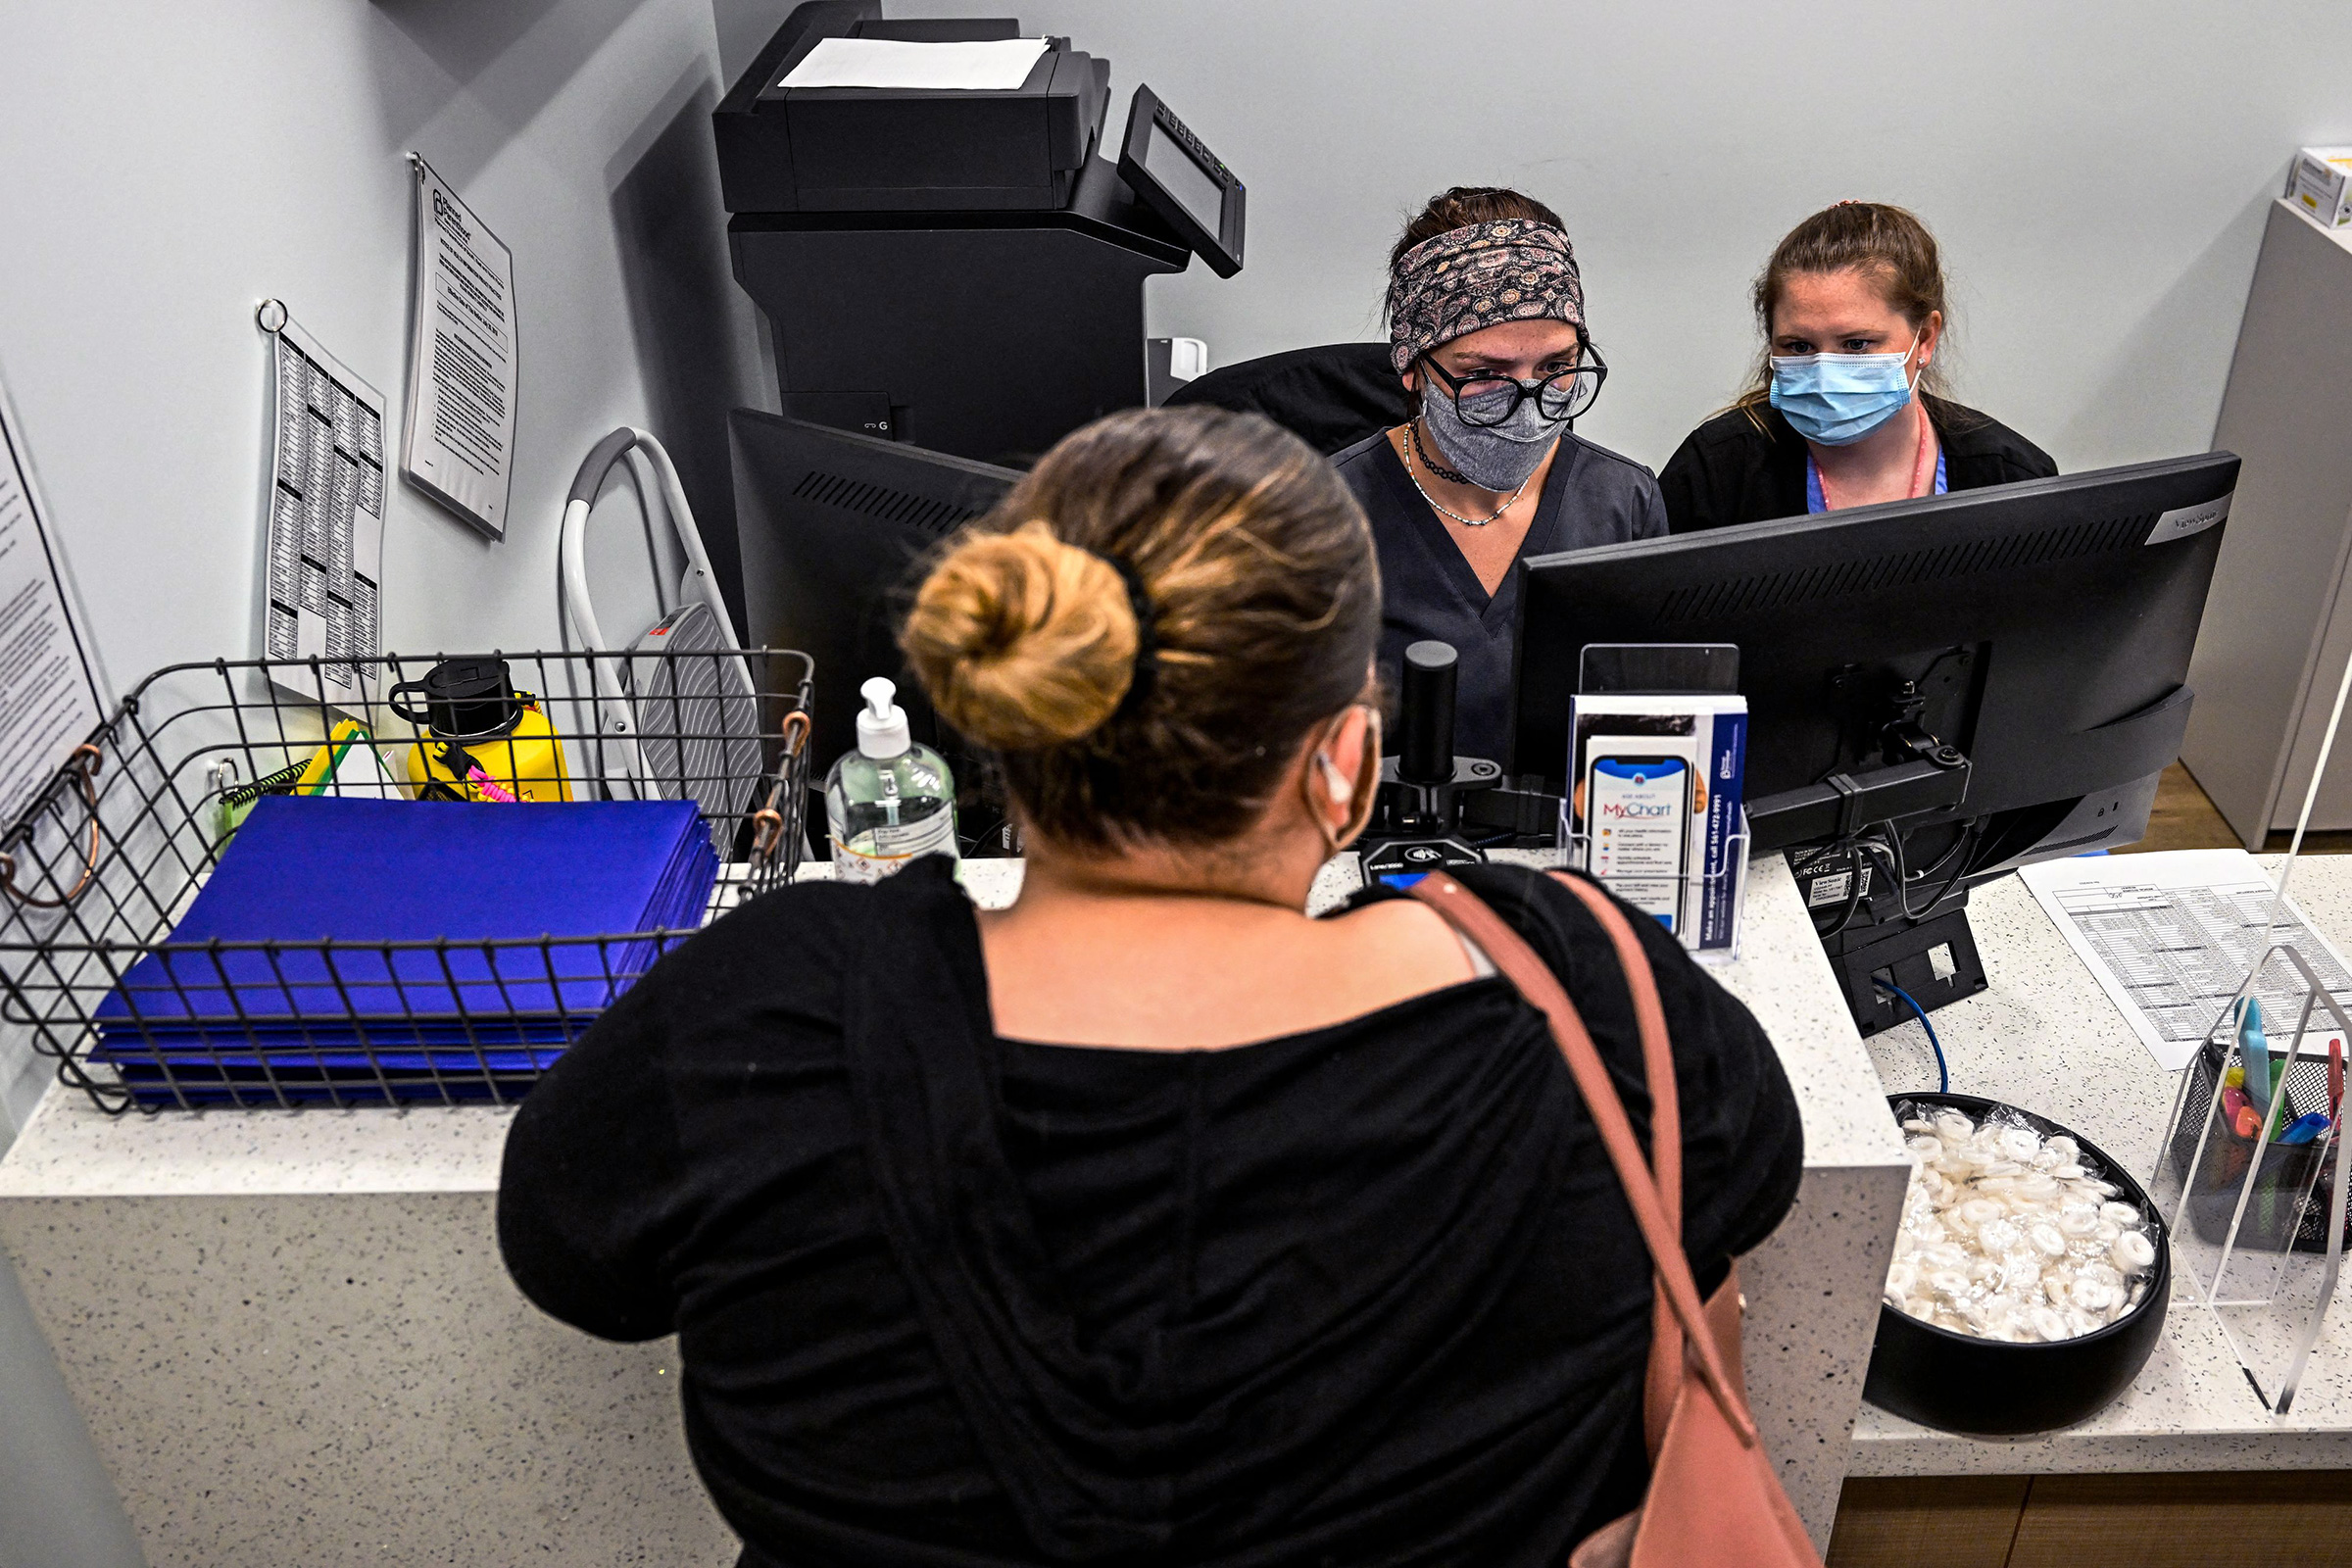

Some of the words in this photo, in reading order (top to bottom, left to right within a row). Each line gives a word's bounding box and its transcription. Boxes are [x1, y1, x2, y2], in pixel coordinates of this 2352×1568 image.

[442, 196, 462, 222] Planned
[879, 421, 888, 430] G
[1603, 802, 1671, 820] MyChart
[1708, 909, 1714, 920] an
